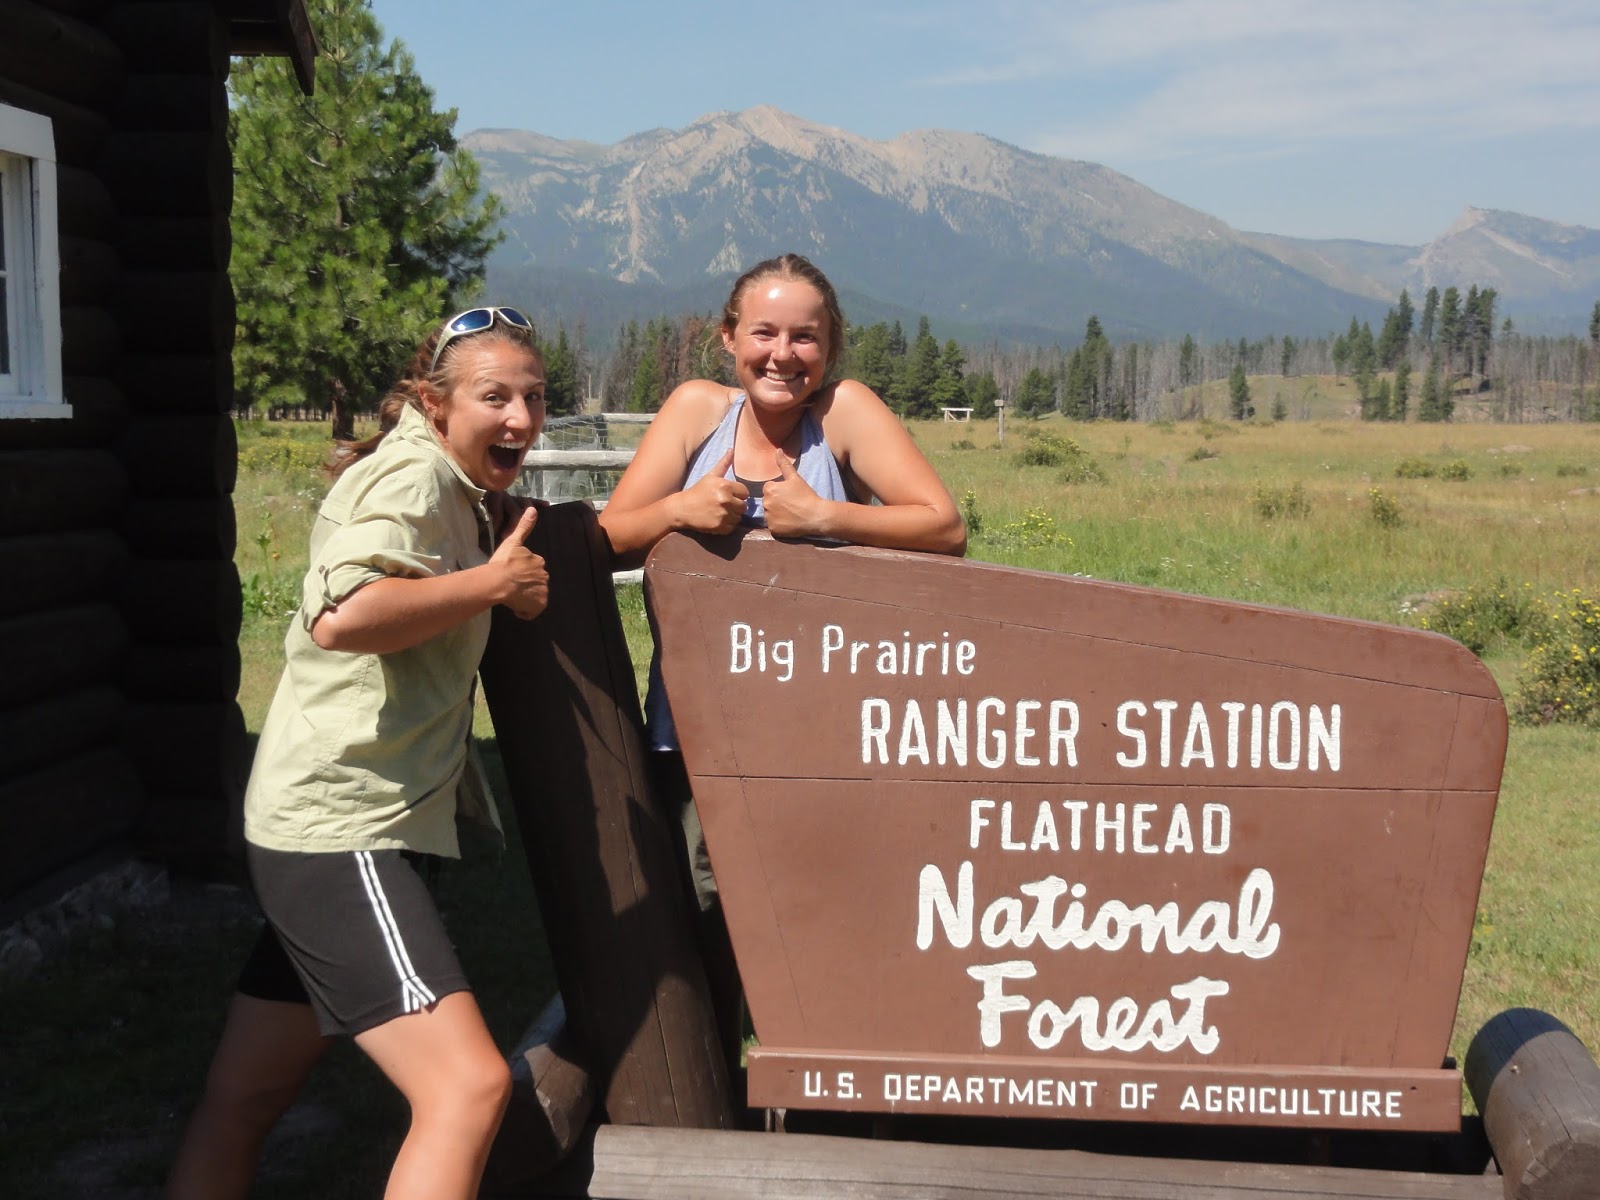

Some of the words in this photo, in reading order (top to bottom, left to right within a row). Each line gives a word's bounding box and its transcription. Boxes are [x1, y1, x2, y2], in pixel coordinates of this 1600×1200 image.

[729, 622, 795, 684] Big
[821, 623, 978, 677] Prairie
[860, 697, 1081, 769] RANGER
[1115, 699, 1343, 773] STATION
[968, 798, 1232, 856] FLATHEAD
[915, 859, 1281, 961] National
[966, 959, 1230, 1056] Forest
[882, 1073, 1099, 1109] DEPARTMENT
[1119, 1081, 1159, 1112] OF
[1178, 1084, 1404, 1120] AGRICULTURE
